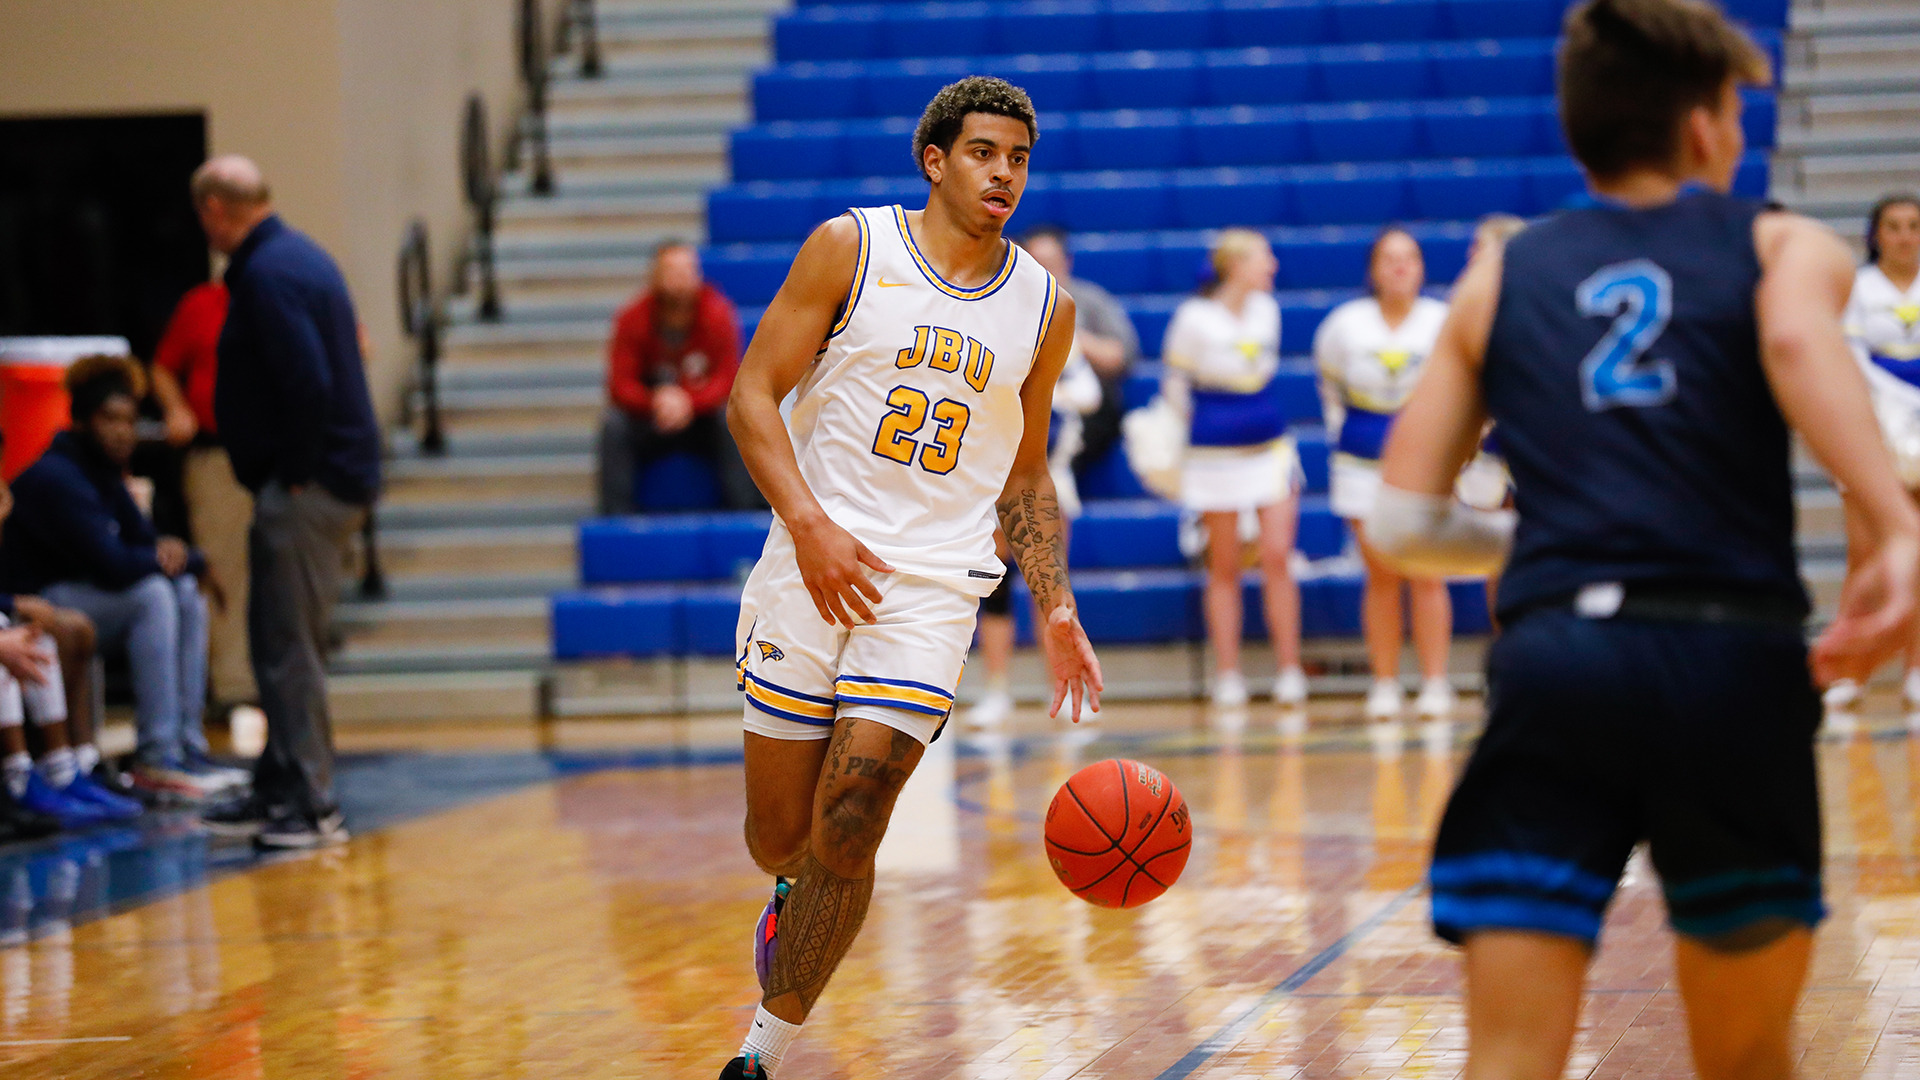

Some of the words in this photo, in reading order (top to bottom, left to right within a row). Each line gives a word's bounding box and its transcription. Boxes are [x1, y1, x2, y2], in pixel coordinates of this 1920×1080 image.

[895, 326, 995, 393] JBU
[1576, 259, 1677, 411] 2
[872, 385, 970, 476] 23
[843, 756, 907, 790] PEAC
